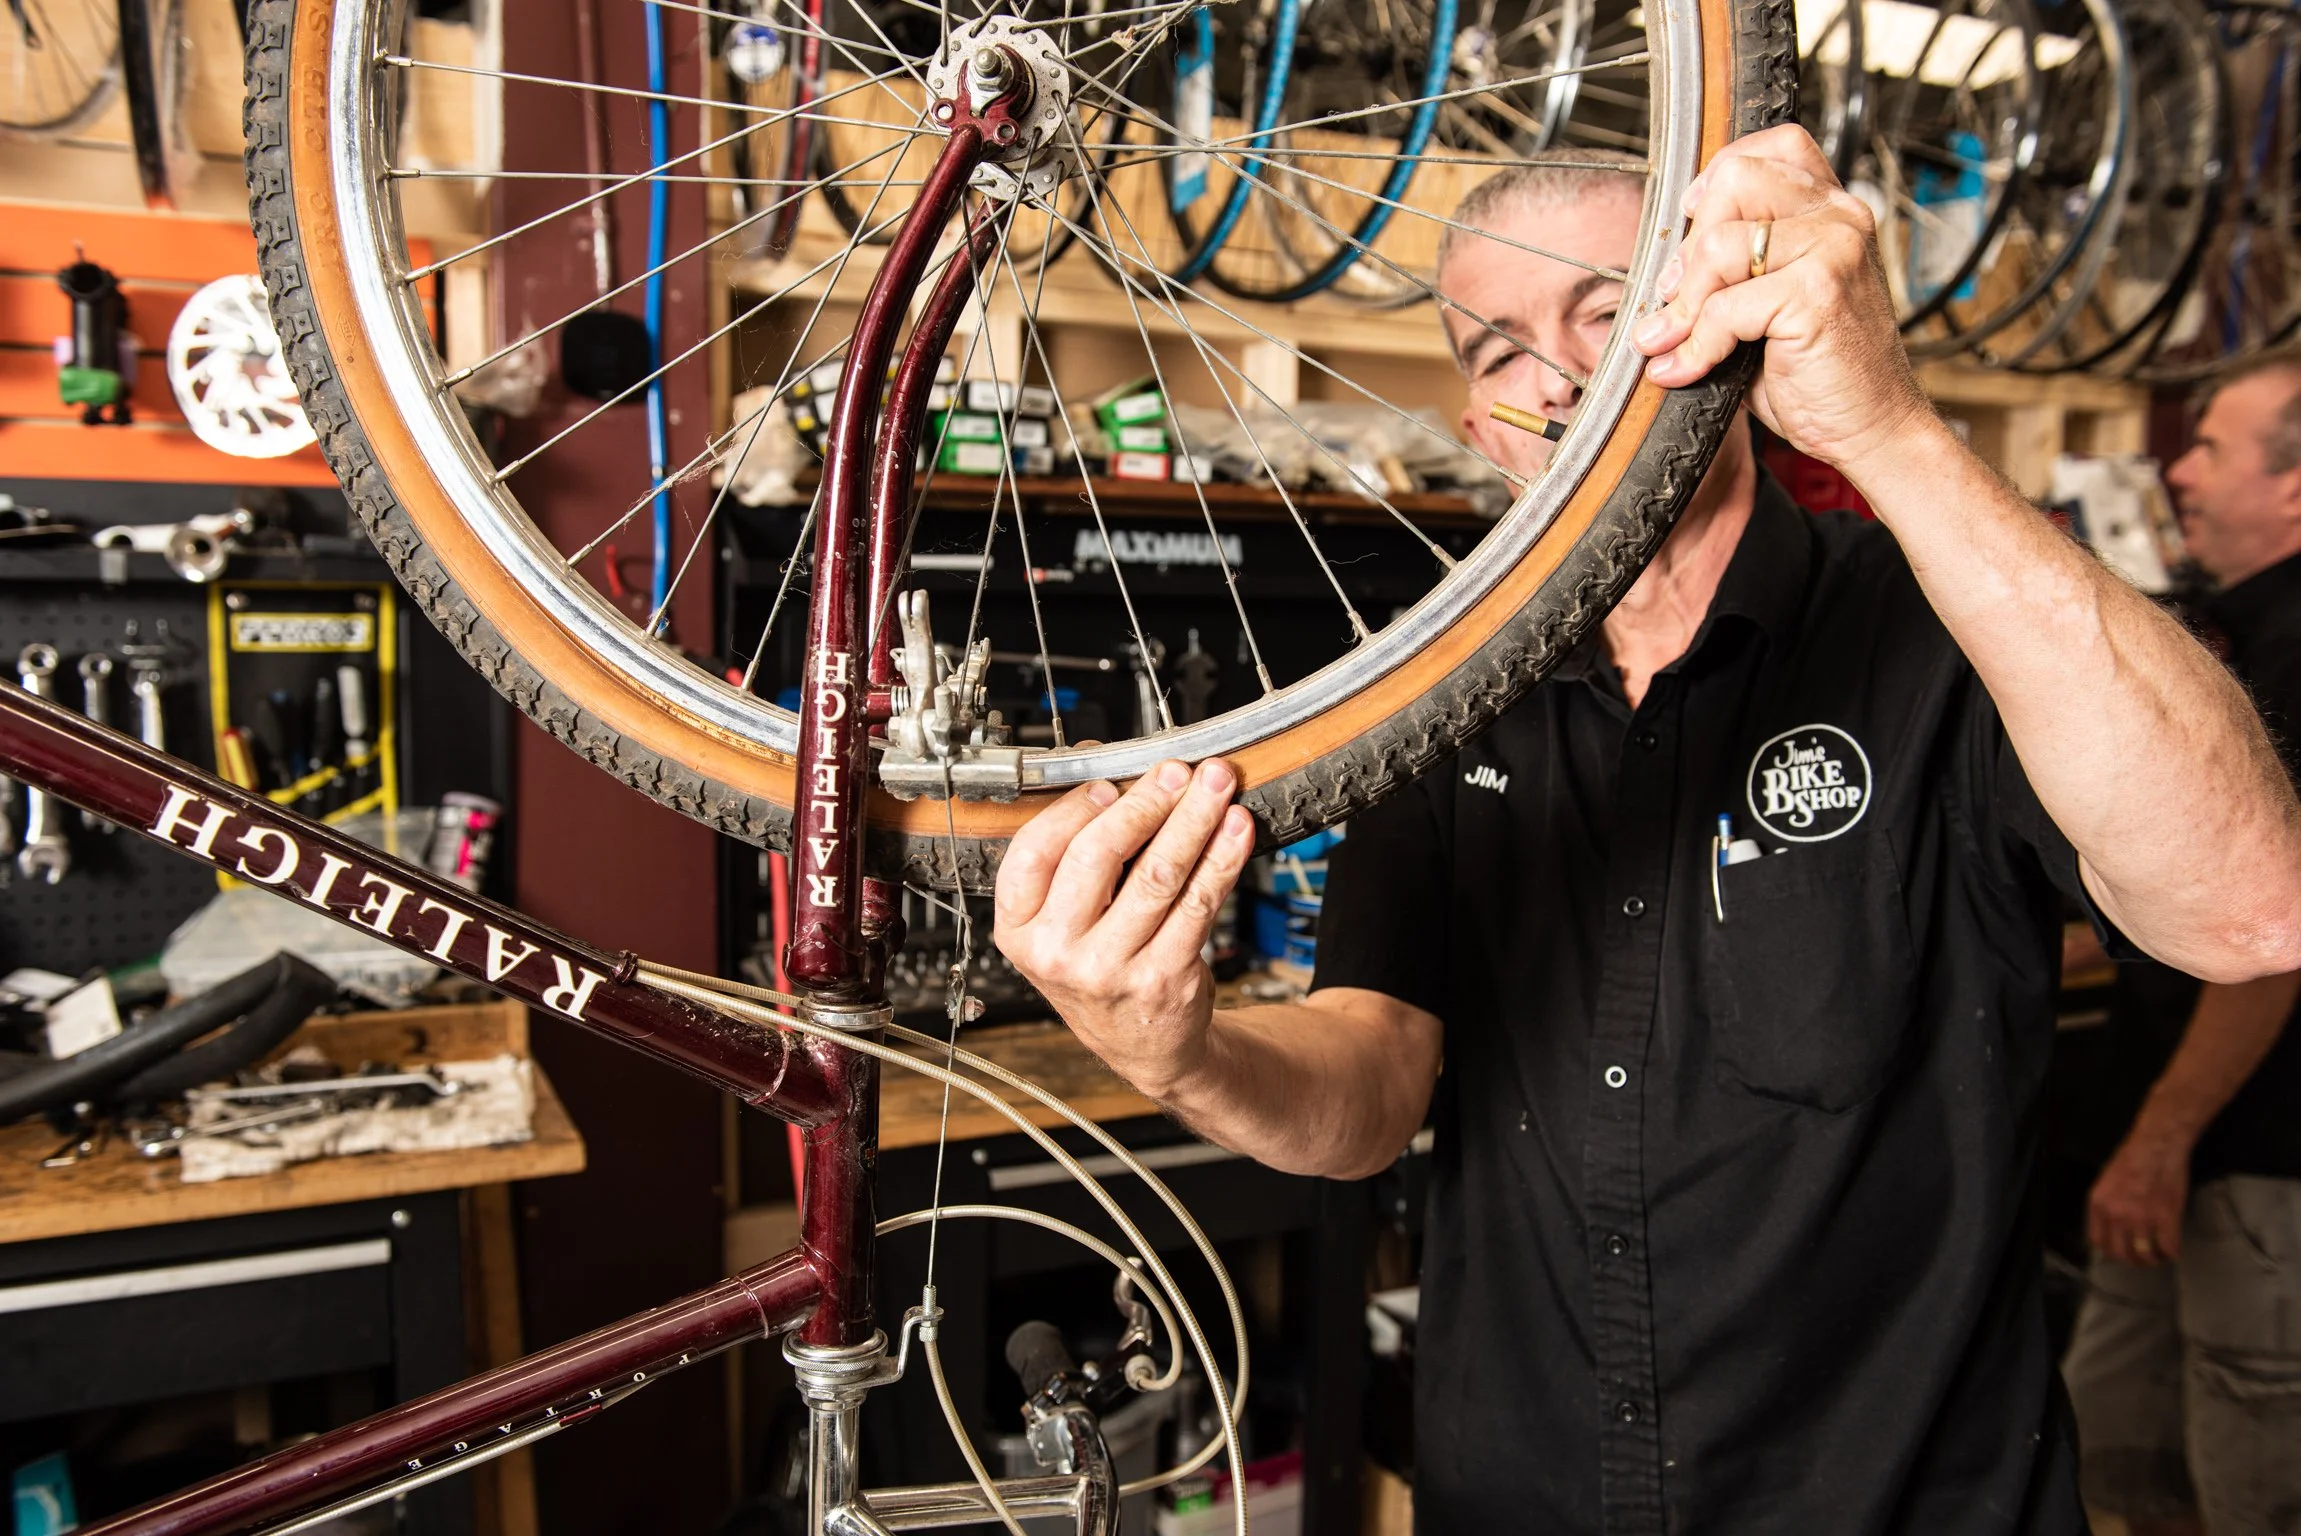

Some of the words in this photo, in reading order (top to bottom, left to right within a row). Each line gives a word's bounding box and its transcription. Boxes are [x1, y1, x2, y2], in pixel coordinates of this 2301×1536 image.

[805, 650, 850, 908] RALEIGH
[1464, 764, 1509, 795] JIM
[1773, 736, 1826, 769] Jim's
[1761, 760, 1846, 818] BIKE
[1788, 785, 1862, 828] SHOP
[146, 783, 608, 1022] RALEIGH
[408, 1354, 692, 1471] PORTAGE
